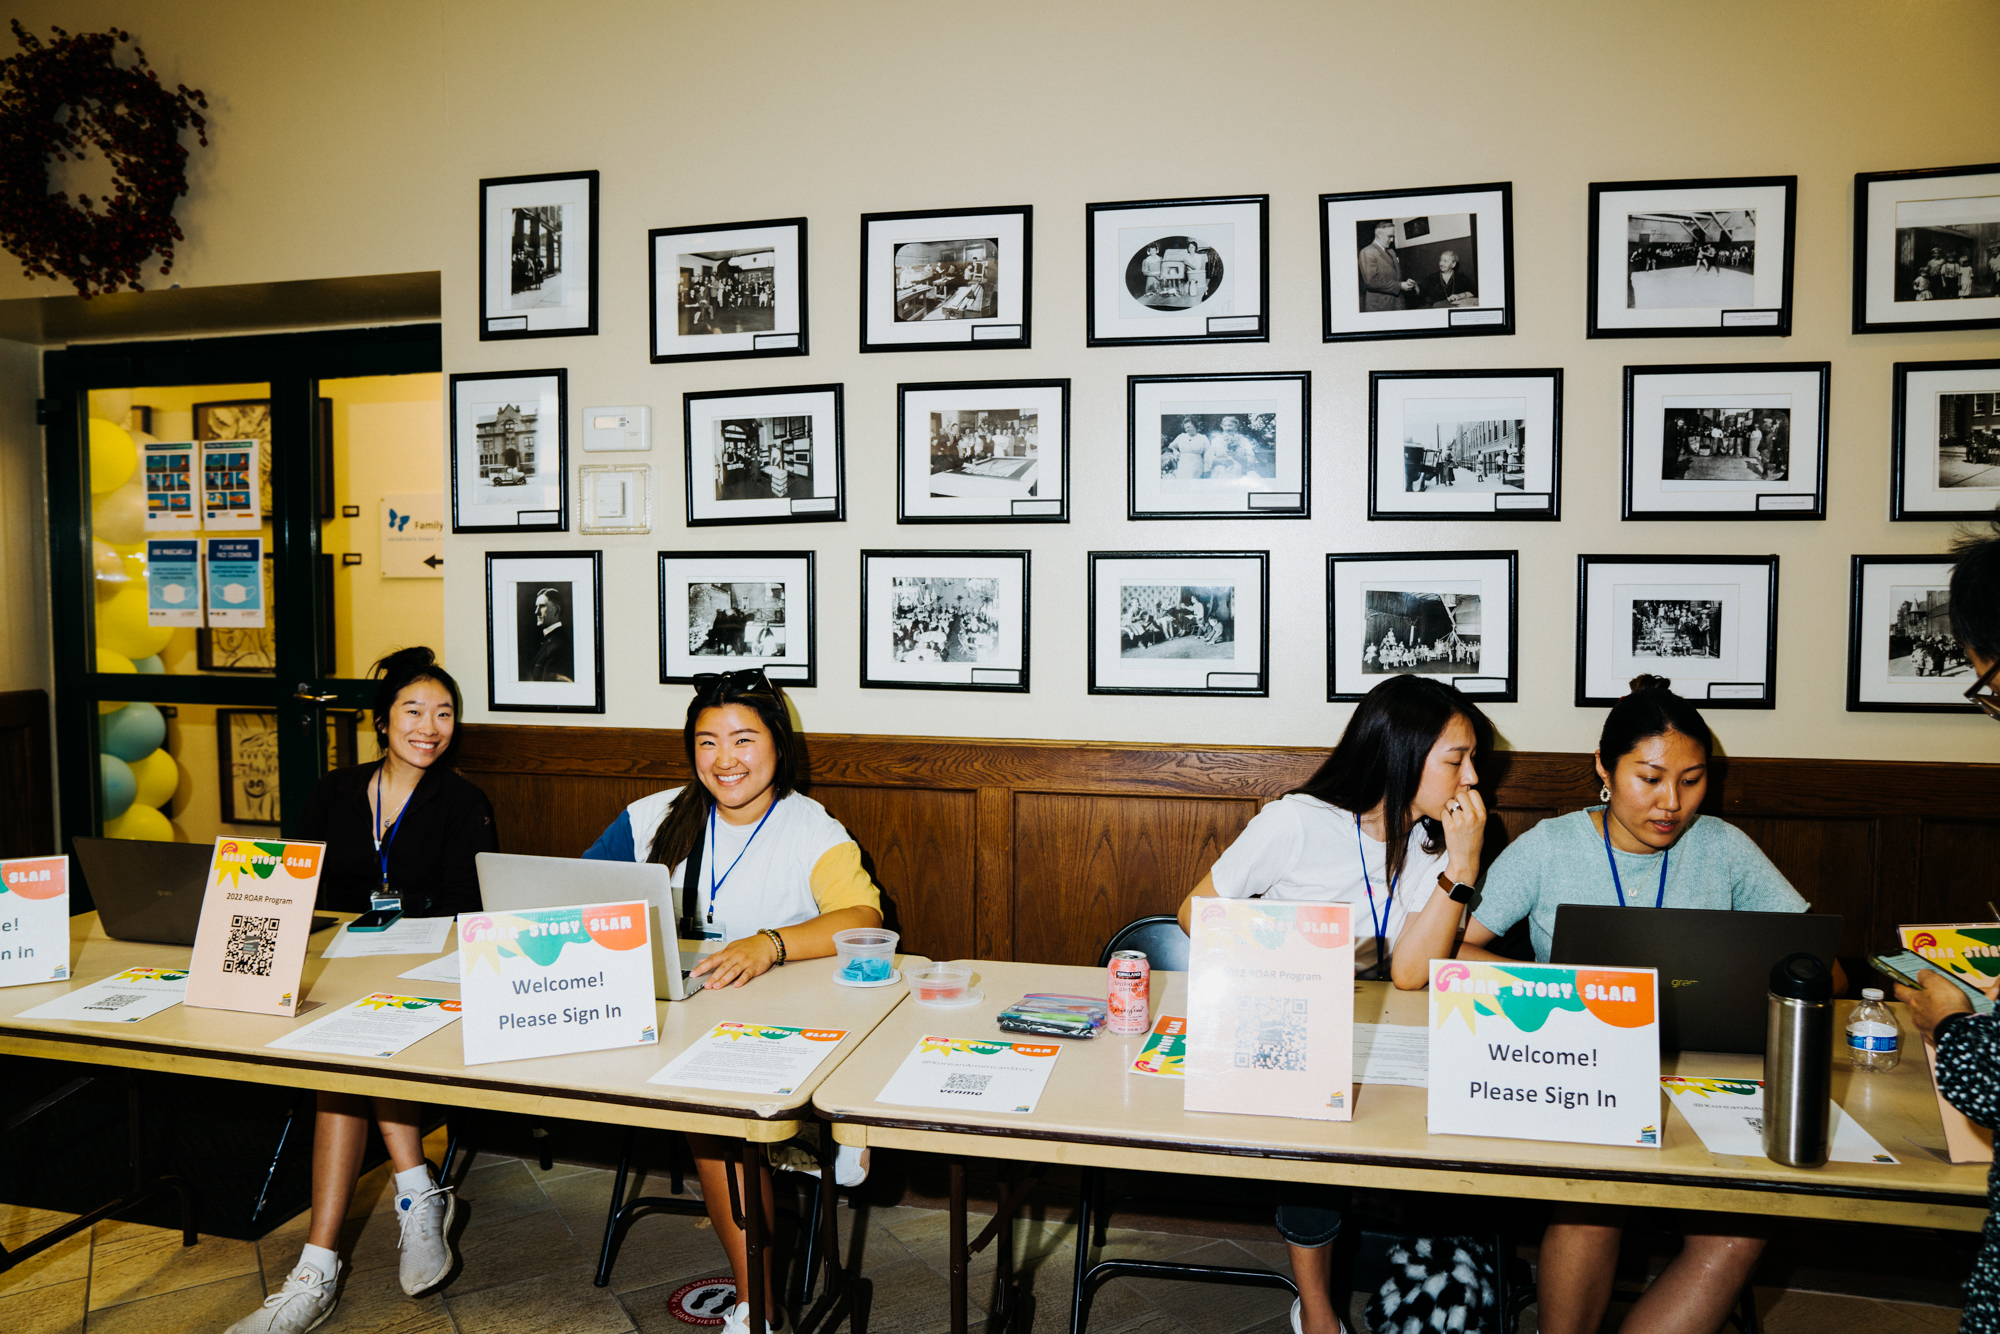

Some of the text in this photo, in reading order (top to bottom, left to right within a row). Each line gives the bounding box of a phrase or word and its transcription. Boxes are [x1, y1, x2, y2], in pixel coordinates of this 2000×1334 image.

[415, 521, 443, 532] Family
[222, 852, 312, 868] ROAR STORY SLAM
[8, 869, 51, 884] SLAM
[226, 892, 293, 905] 2022 ROAR Program
[475, 915, 632, 942] ROAR STORY SLAM
[1302, 922, 1340, 935] SLAM
[18, 946, 35, 959] In
[1918, 945, 2000, 959] ROAR STOR
[1248, 969, 1276, 979] ROAR
[1279, 970, 1322, 982] Program
[512, 971, 604, 995] Welcome!
[1449, 977, 1500, 995] ROAR
[1511, 980, 1573, 999] STORY
[1585, 984, 1637, 1002] SLAM
[1671, 979, 1699, 988] gram
[499, 1004, 622, 1030] Please Sign In
[721, 1025, 754, 1033] ROAR
[927, 1040, 962, 1048] ROAR
[968, 1043, 1012, 1051] STORY
[1488, 1042, 1597, 1067] Welcome!
[921, 1060, 1035, 1073] @KoreanAmericanStory
[940, 1088, 983, 1096] venmo
[1470, 1081, 1617, 1109] Please Sign In
[672, 1309, 695, 1323] STAND
